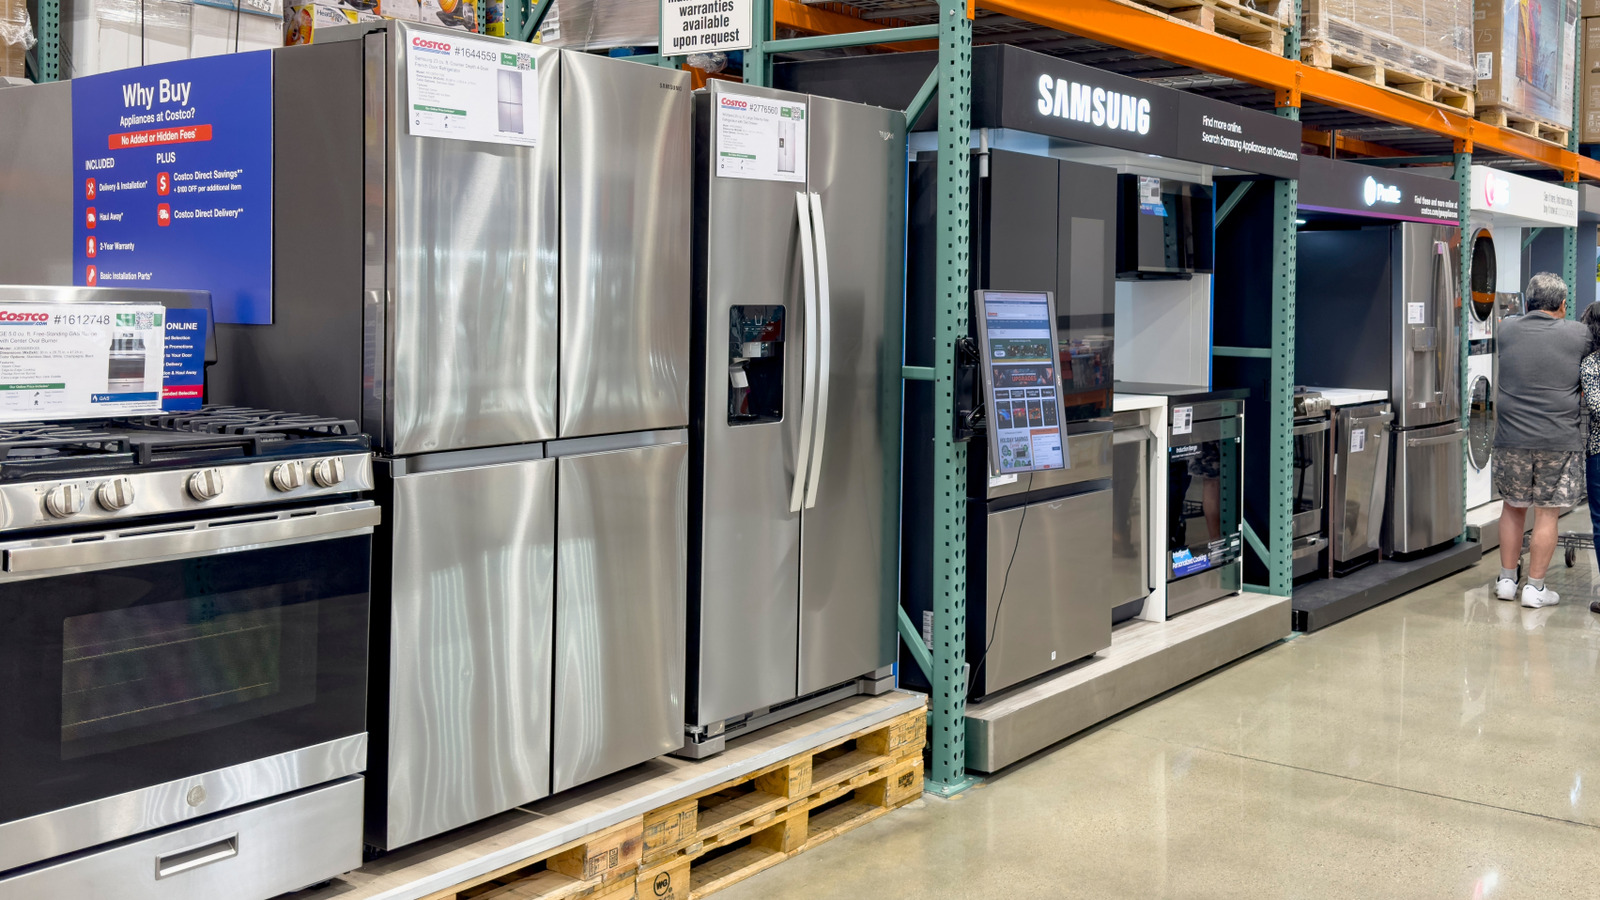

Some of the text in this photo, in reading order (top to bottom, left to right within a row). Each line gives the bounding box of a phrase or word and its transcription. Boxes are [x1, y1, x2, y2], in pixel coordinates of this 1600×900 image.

[679, 0, 734, 17] warranties
[682, 14, 730, 31] available
[673, 28, 740, 49] upon request
[412, 37, 451, 51] COSTCO
[454, 46, 497, 62] #1644559
[659, 82, 683, 92] SAMSUNG
[122, 78, 192, 110] Why Buy
[721, 97, 747, 108] COSTCO
[749, 104, 778, 115] #2776560
[1037, 73, 1151, 135] SAMSUNG
[119, 107, 196, 128] Appliances at Costco?
[1202, 115, 1242, 134] Find more online.
[121, 136, 129, 146] No
[129, 133, 148, 145] Added
[149, 134, 155, 143] or
[156, 130, 179, 142] Hidden
[1202, 131, 1220, 144] Search
[1220, 135, 1242, 152] Samsung
[1242, 140, 1266, 154] Appliances
[1266, 147, 1273, 156] on
[85, 157, 115, 171] INCLUDED
[156, 151, 176, 164] PLUS
[173, 172, 193, 181] Costco
[194, 170, 212, 180] Direct
[98, 183, 116, 192] Delivery
[116, 182, 120, 190] &
[188, 184, 197, 193] OFF
[198, 185, 206, 193] per
[206, 183, 230, 192] additional
[99, 213, 110, 221] Haul
[174, 209, 194, 219] Costco
[195, 209, 213, 218] Direct
[99, 242, 135, 252] 2-Year Warranty
[100, 272, 112, 280] Basic
[112, 271, 137, 280] Installation
[54, 314, 110, 325] #1612748
[166, 322, 198, 330] ONLINE
[656, 878, 668, 890] WG
